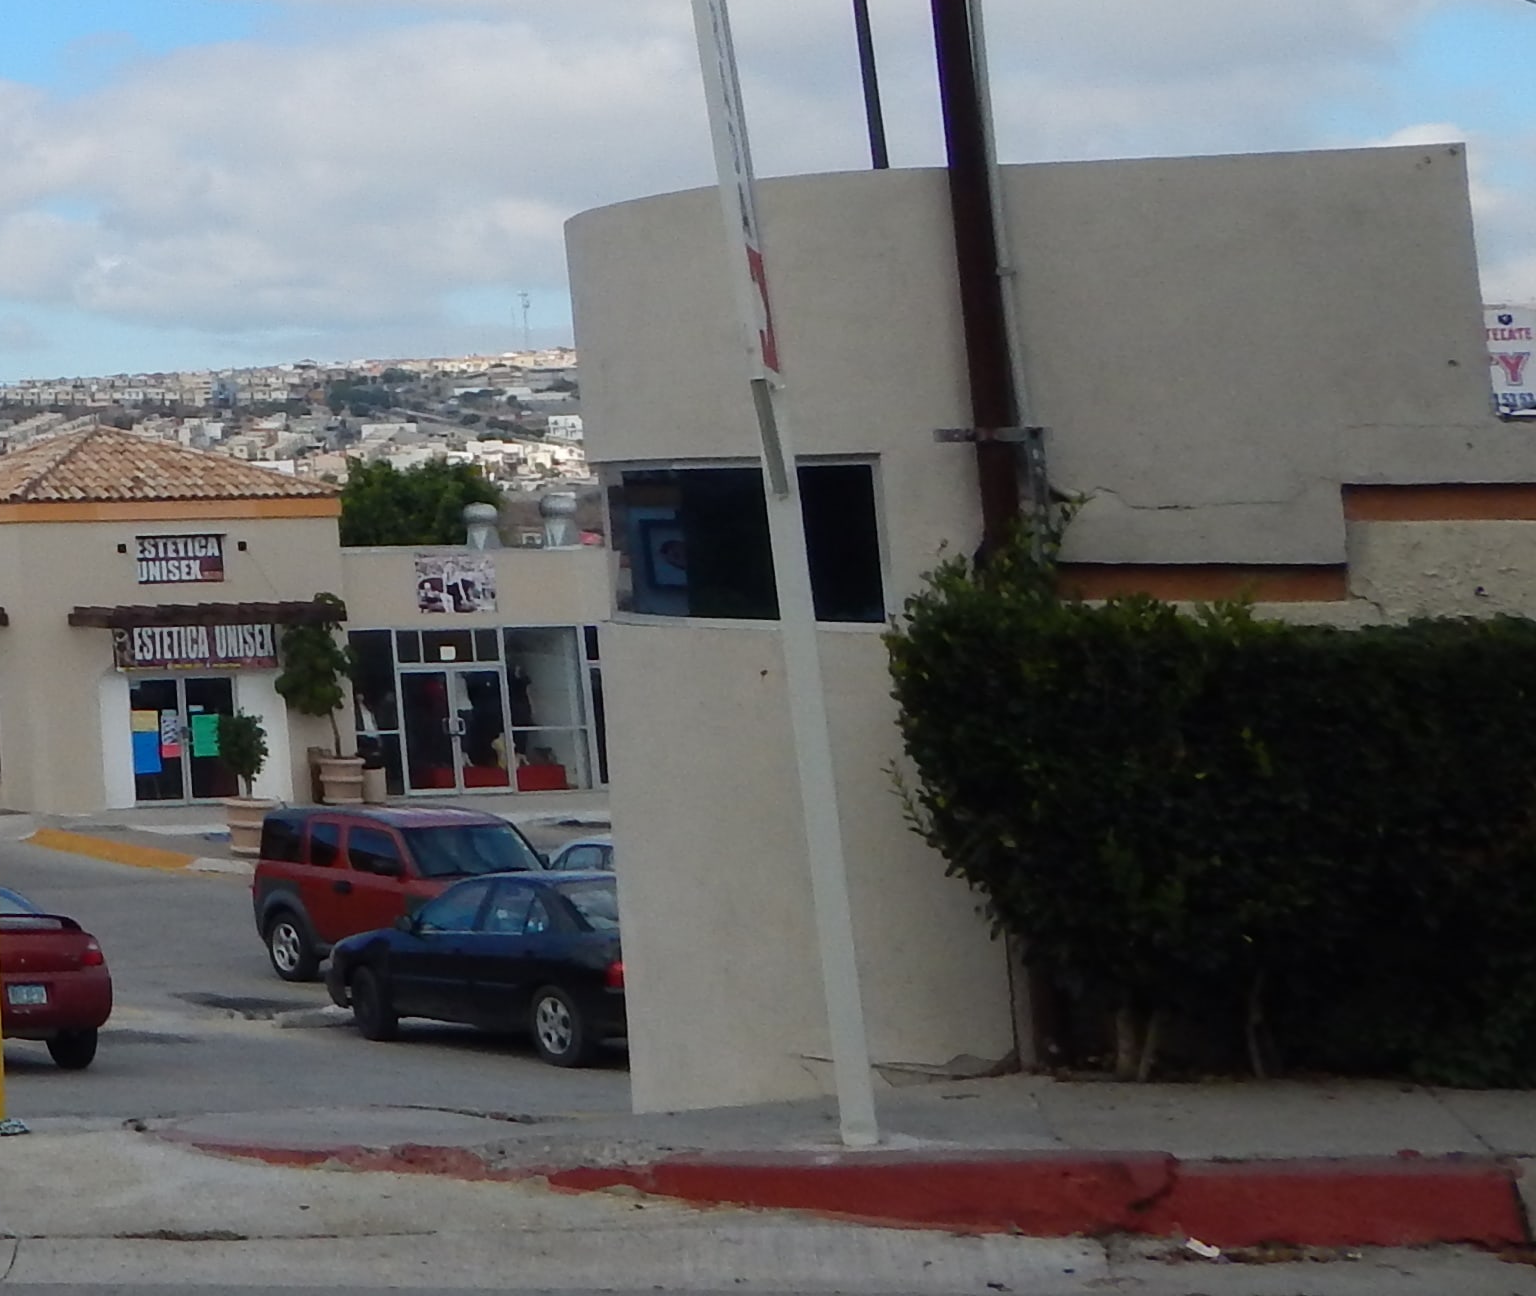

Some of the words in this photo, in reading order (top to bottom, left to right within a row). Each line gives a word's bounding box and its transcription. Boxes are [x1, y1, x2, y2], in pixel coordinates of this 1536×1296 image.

[137, 536, 220, 558] ESTETICA
[138, 559, 203, 581] UNISEX
[133, 626, 209, 660] ESTETICA
[215, 624, 274, 659] UNISEX
